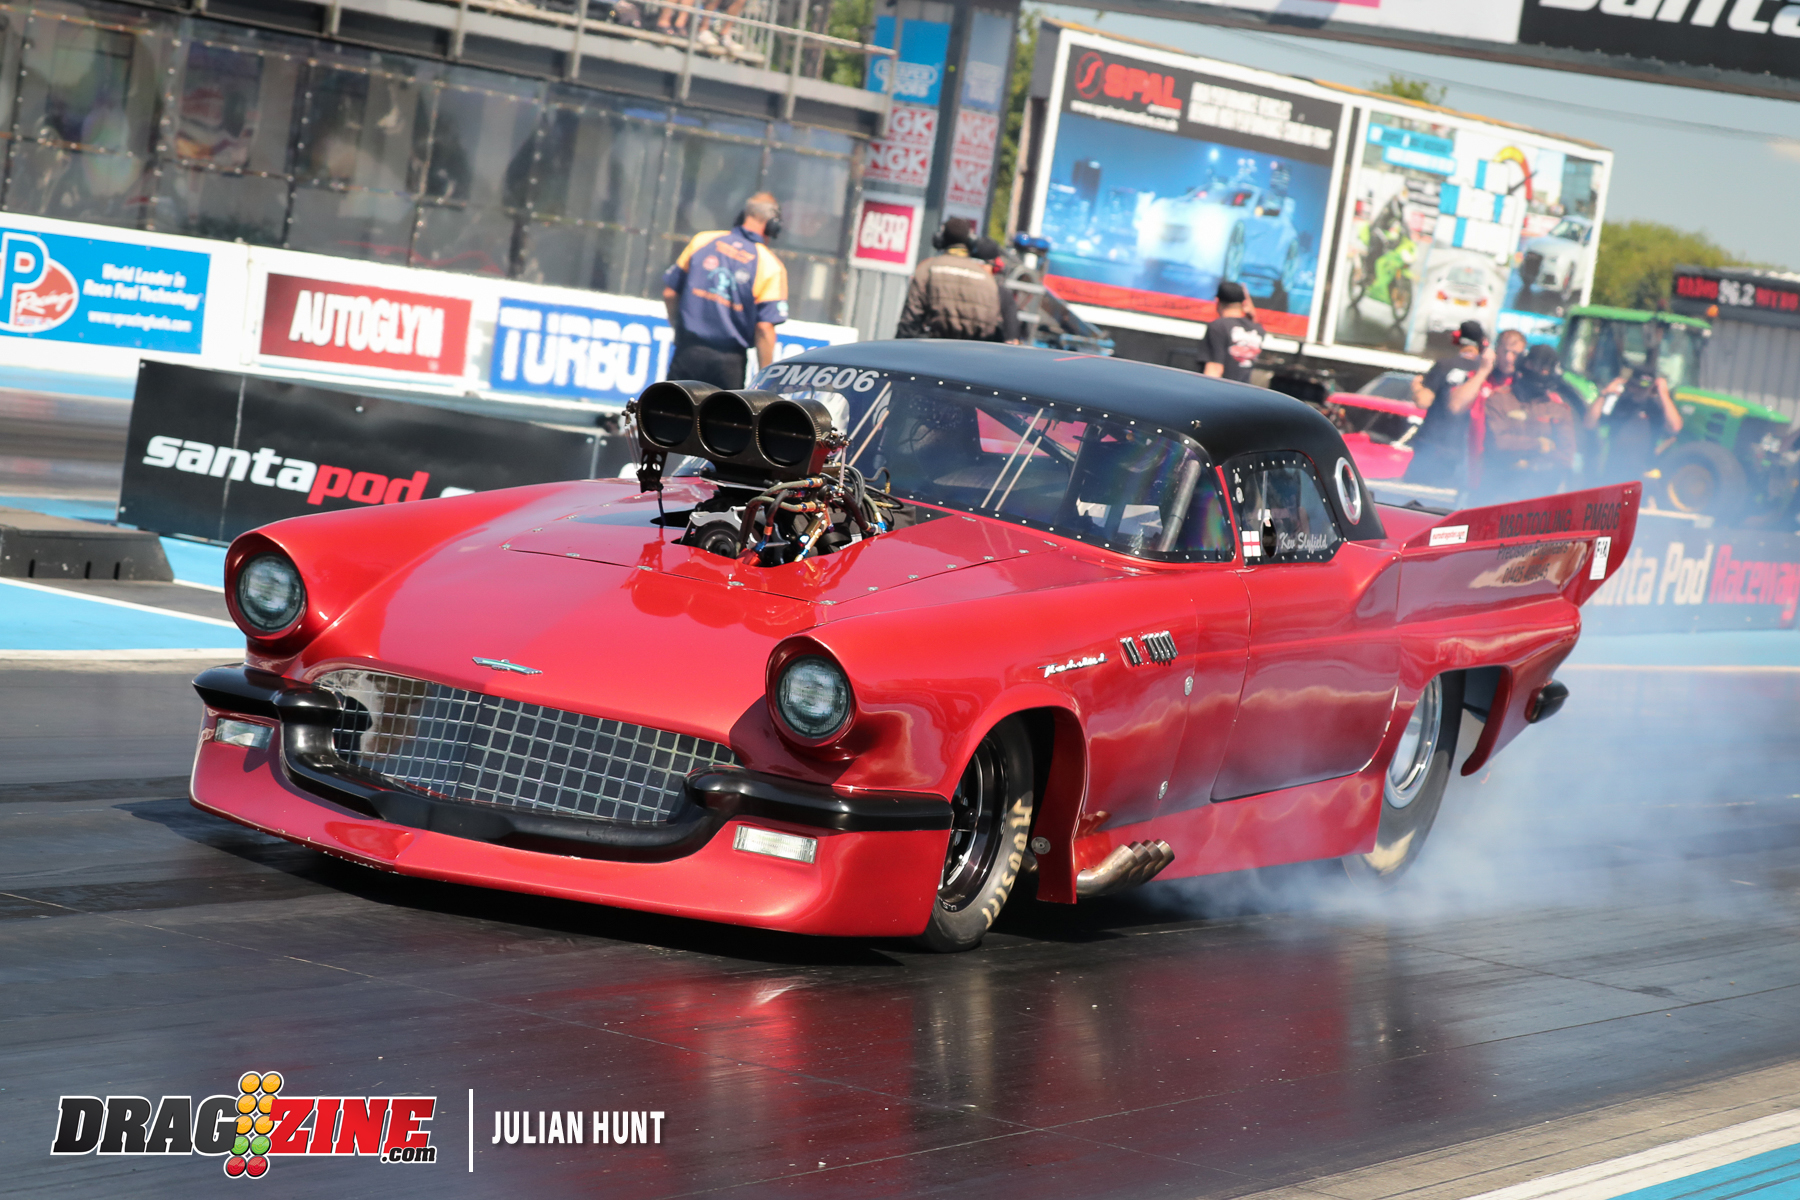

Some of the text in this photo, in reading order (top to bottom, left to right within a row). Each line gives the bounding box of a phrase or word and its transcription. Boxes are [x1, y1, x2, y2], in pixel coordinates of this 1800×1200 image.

[1103, 63, 1182, 110] SPAL
[891, 110, 934, 137] GK
[866, 141, 928, 174] NGK
[114, 282, 139, 300] Fuel
[288, 289, 445, 358] AUTOGLYM
[760, 364, 880, 393] PM606
[1526, 509, 1573, 536] TOOLING
[1582, 502, 1622, 531] PM606
[1279, 532, 1297, 549] Kev
[1657, 542, 1715, 606] Pod
[1708, 544, 1800, 620] Raceway
